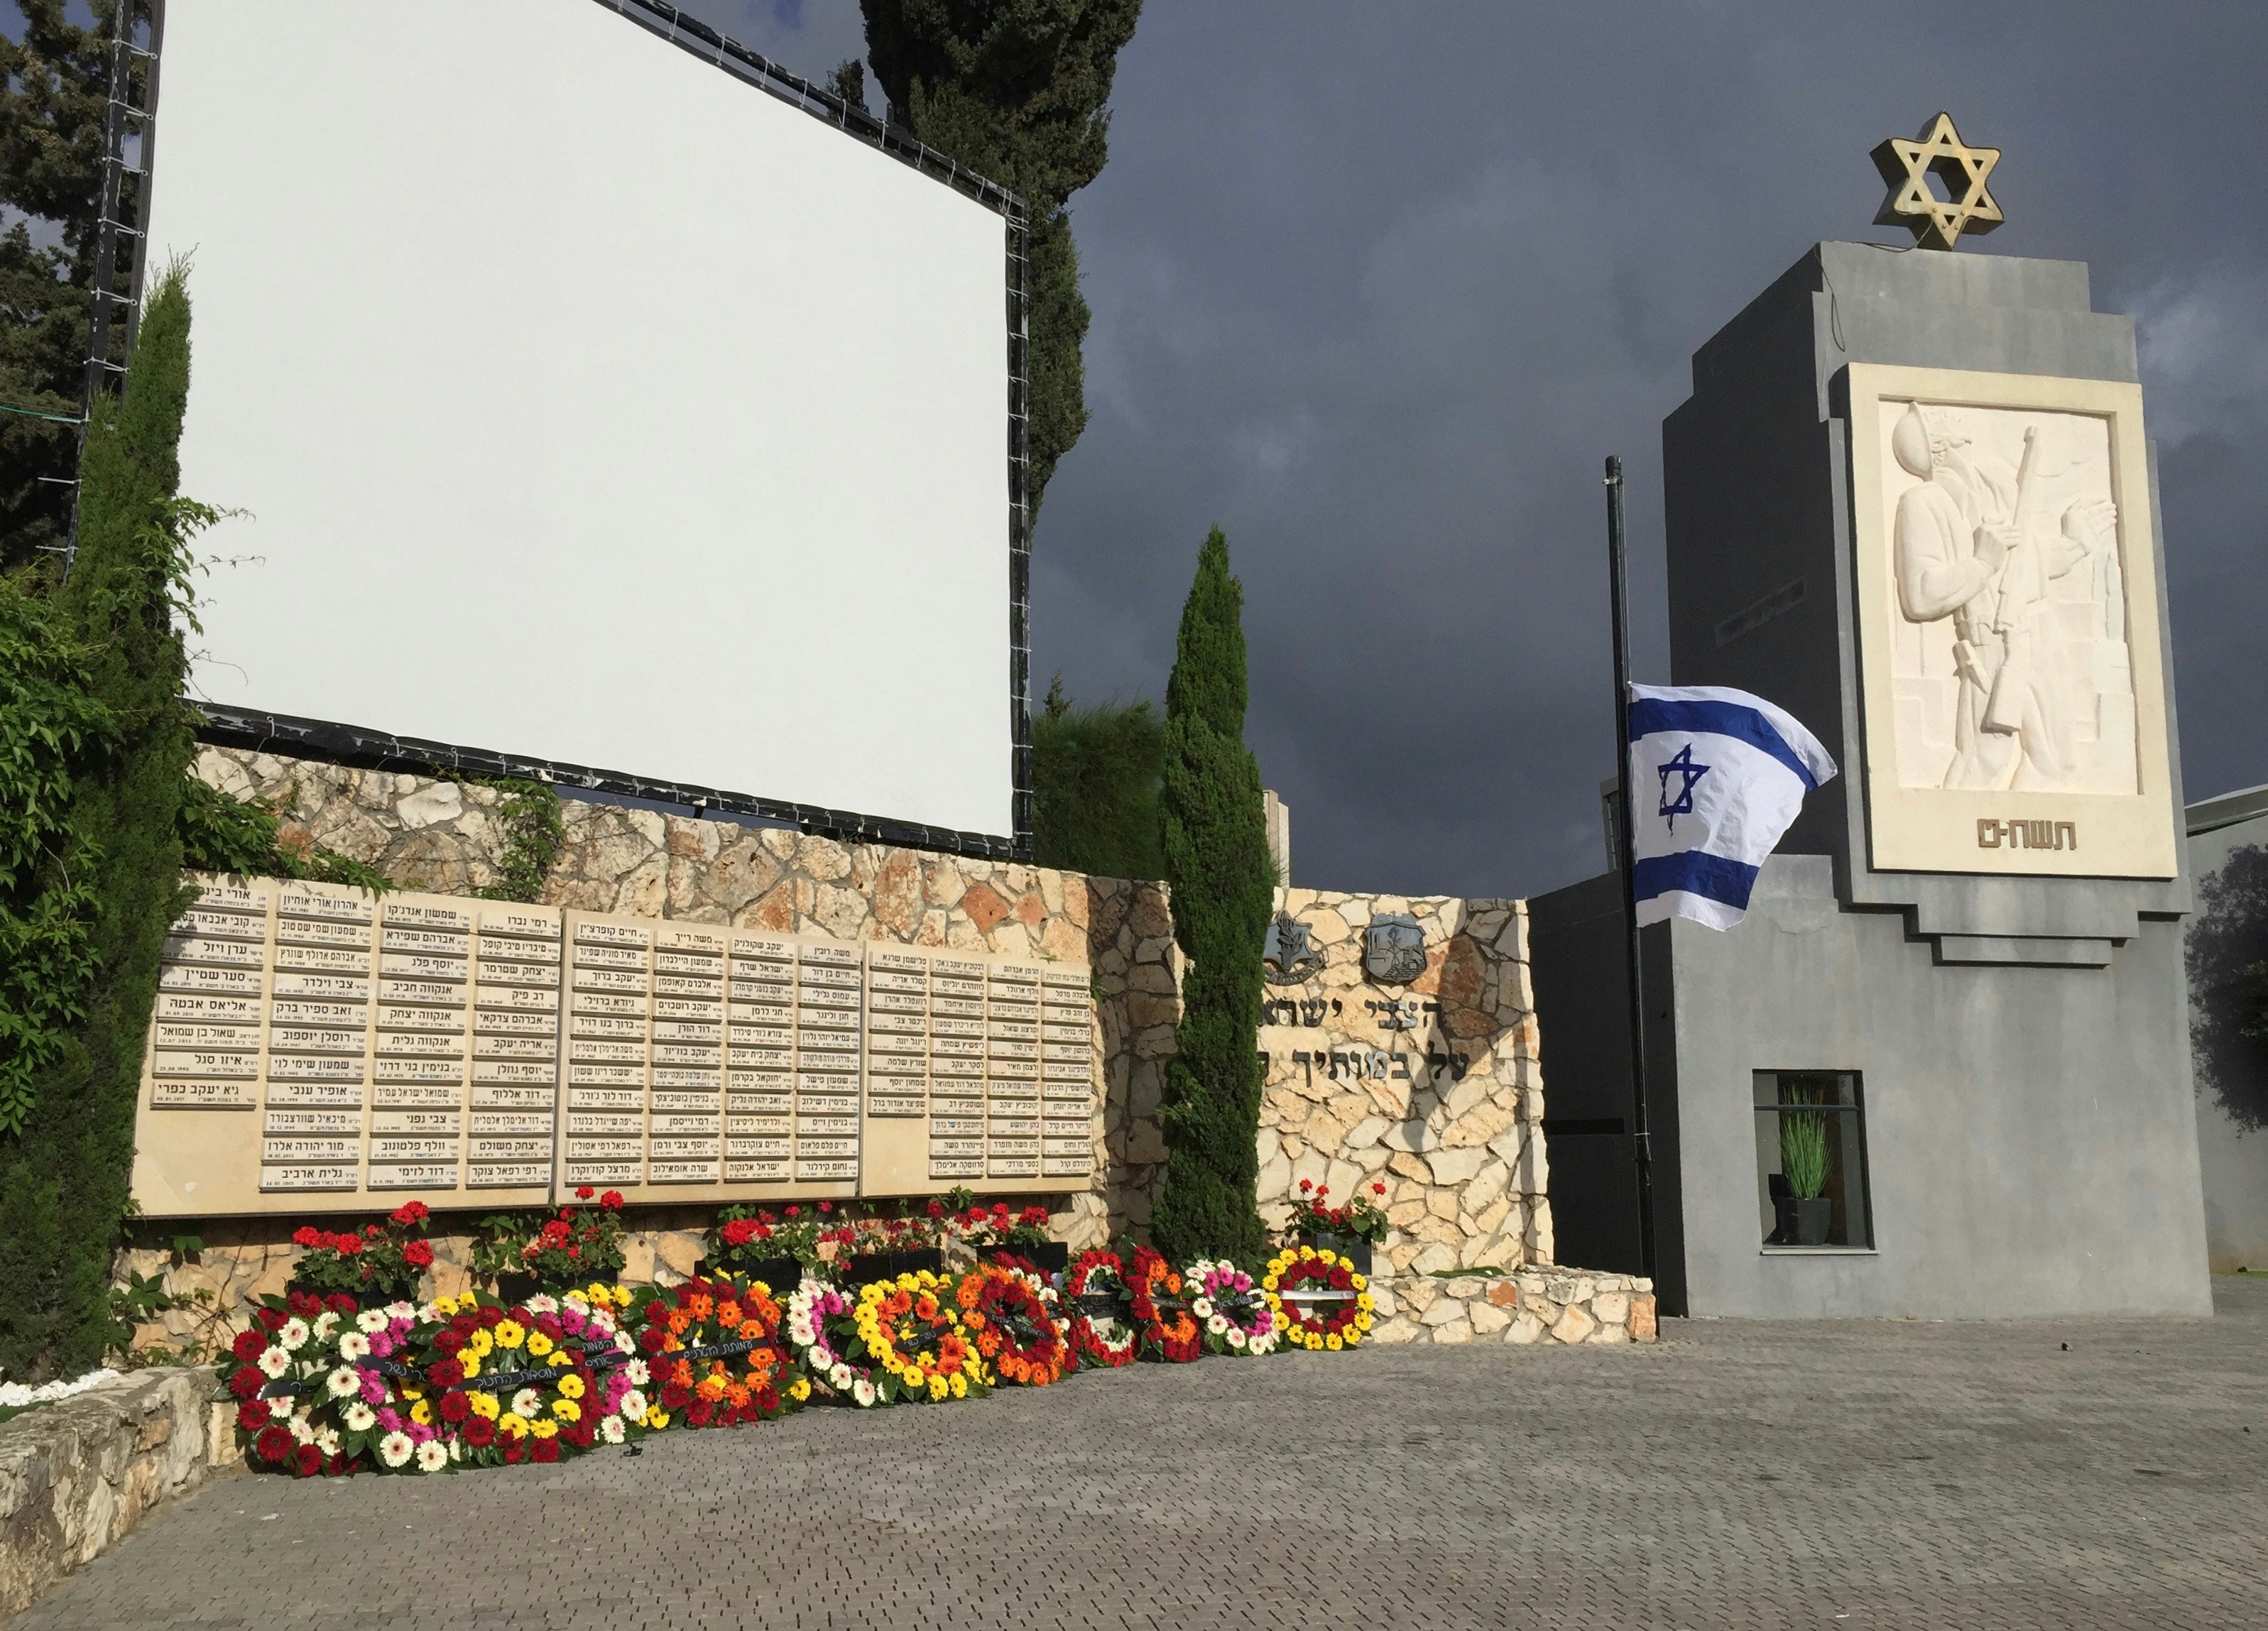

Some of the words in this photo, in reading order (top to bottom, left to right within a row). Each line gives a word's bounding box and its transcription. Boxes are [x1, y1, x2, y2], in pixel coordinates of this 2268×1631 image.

[226, 888, 251, 900] אורי
[283, 895, 311, 906] אוחיון
[312, 897, 332, 908] אורי
[332, 899, 359, 911] אהרון
[424, 908, 457, 920] שמשון
[229, 916, 250, 929] קובי
[329, 924, 357, 937] שמעון
[386, 930, 420, 942] שפירא
[422, 933, 456, 944] אברהם
[692, 934, 713, 944] משה
[202, 941, 224, 954] ויזל
[227, 944, 248, 956] ערן
[833, 948, 851, 958] משה
[329, 951, 356, 962] אברהם
[410, 956, 430, 968] פלג
[432, 959, 454, 971] יוסף
[758, 963, 784, 973] ישראל
[182, 969, 220, 981] שטיין
[221, 971, 246, 982] סער
[521, 966, 546, 977] יצחק
[302, 977, 332, 988] וילדר
[614, 973, 636, 984] יעקב
[334, 979, 353, 990] צבי
[392, 982, 418, 993] חביב
[419, 983, 453, 995] אנקווה
[511, 990, 529, 1001] פיק
[532, 991, 545, 1001] דב
[169, 998, 204, 1010] אבטה
[209, 1000, 247, 1011] אליאס
[276, 1003, 299, 1014] ברק
[302, 1003, 329, 1015] ספיר
[332, 1005, 352, 1016] זאב
[389, 1008, 416, 1020] יצחק
[418, 1010, 452, 1022] אנקווה
[1256, 998, 1343, 1027] ישרא
[1364, 999, 1442, 1030] הצבי
[479, 1013, 510, 1025] צדקאי
[511, 1015, 543, 1025] אברהם
[160, 1025, 195, 1037] שמואל
[196, 1027, 208, 1039] בן
[209, 1027, 236, 1038] שאול
[697, 1025, 711, 1034] דוד
[281, 1030, 317, 1041] יוספוב
[320, 1031, 351, 1044] רוסלן
[391, 1035, 415, 1045] גלית
[417, 1036, 451, 1048] אנקווה
[493, 1038, 518, 1049] יעקב
[518, 1039, 543, 1049] אריה
[194, 1053, 216, 1065] סגל
[731, 1049, 750, 1059] יעקב
[749, 1050, 763, 1059] בית
[763, 1050, 782, 1061] יצחק
[219, 1055, 243, 1066] איזו
[273, 1057, 288, 1069] לוי
[290, 1059, 316, 1069] שימי
[317, 1059, 350, 1071] שמעון
[1429, 1041, 1469, 1081] על
[403, 1062, 418, 1071] בני
[421, 1062, 450, 1074] בנימין
[520, 1065, 543, 1076] יוסף
[1292, 1049, 1410, 1088] במותיך
[157, 1084, 187, 1094] כפרי
[189, 1084, 220, 1097] יעקב
[222, 1085, 239, 1096] גיא
[288, 1085, 314, 1096] ענבי
[316, 1086, 348, 1096] אופיר
[397, 1086, 423, 1098] ישראל
[423, 1087, 449, 1098] שמואל
[524, 1090, 540, 1099] דוד
[405, 1114, 426, 1124] גפני
[428, 1114, 447, 1124] צבי
[294, 1141, 325, 1151] יהודה
[326, 1141, 344, 1151] מור
[479, 1140, 513, 1151] משולם
[513, 1141, 538, 1152] יצחק
[673, 1140, 689, 1150] צבי
[689, 1140, 709, 1151] יוסף
[281, 1169, 315, 1179] ארביב
[317, 1167, 343, 1179] גלית
[427, 1167, 445, 1177] דוד
[471, 1167, 494, 1178] צוקר
[496, 1165, 520, 1176] רפאל
[521, 1166, 538, 1175] רפי
[384, 1361, 407, 1376] נשר
